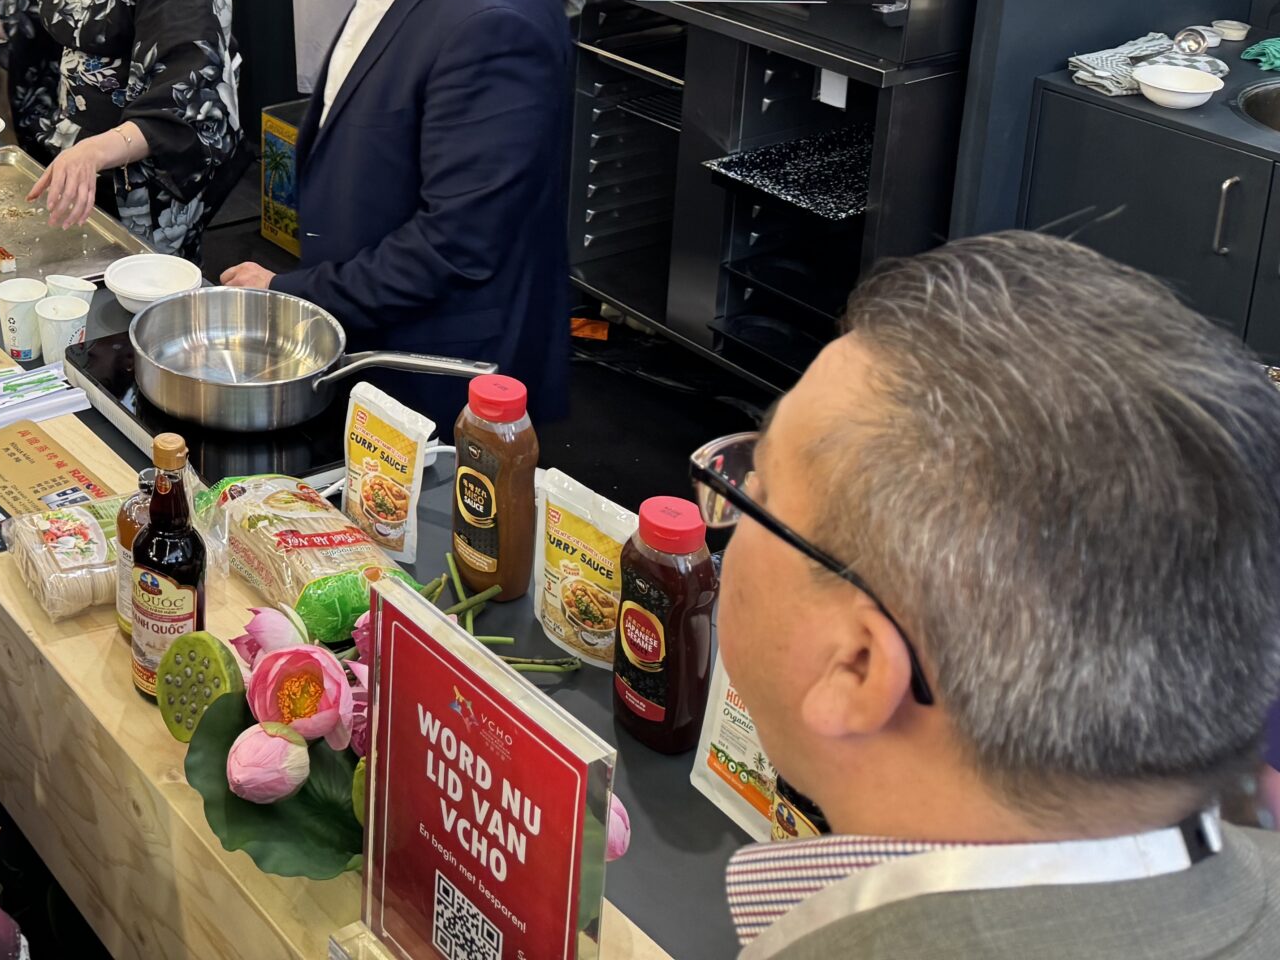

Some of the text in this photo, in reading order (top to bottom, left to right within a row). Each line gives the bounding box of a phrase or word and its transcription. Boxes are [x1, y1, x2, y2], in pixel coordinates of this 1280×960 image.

[349, 432, 408, 474] CURRY SAUCE
[463, 495, 484, 514] SAUCE
[464, 486, 485, 505] MISO
[230, 556, 244, 571] Rice
[579, 552, 614, 580] SAUCE
[625, 621, 659, 648] JAPANESE
[627, 628, 653, 653] SESAME
[481, 713, 513, 746] VCHO
[723, 707, 754, 733] Organic
[417, 702, 492, 790] WORD
[501, 778, 541, 836] NU
[426, 749, 527, 865] LID VAN
[440, 797, 507, 882] VCHO
[419, 822, 527, 934] En begin met besparen!
